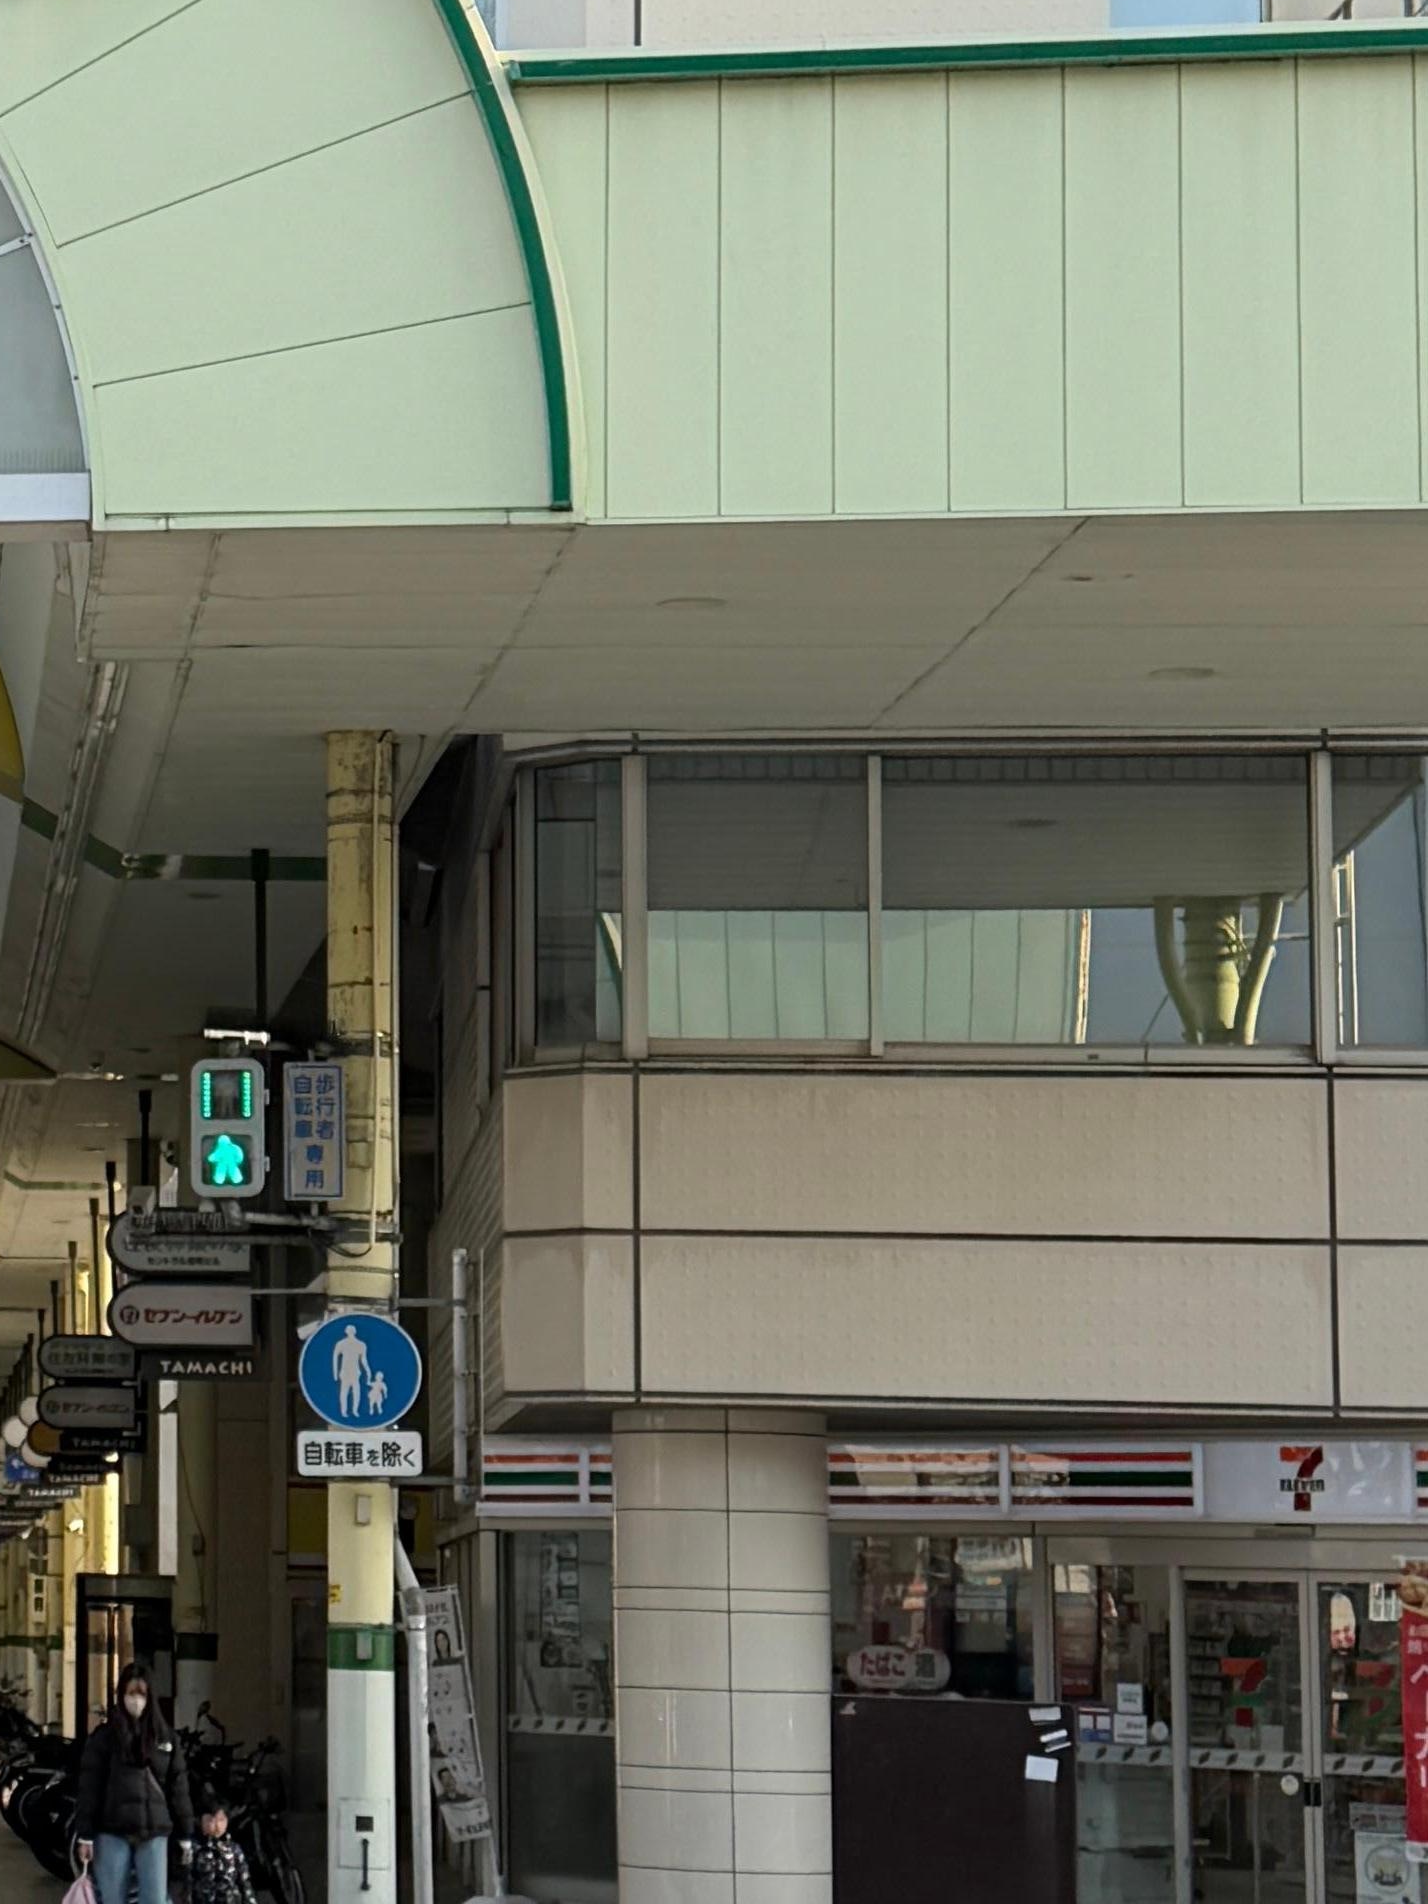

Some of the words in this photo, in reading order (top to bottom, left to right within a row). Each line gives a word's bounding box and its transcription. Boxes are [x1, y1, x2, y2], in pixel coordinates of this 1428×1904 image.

[293, 1074, 312, 1139] 自転車
[315, 1074, 335, 1140] 歩行者
[305, 1144, 324, 1190] 専用
[160, 1360, 253, 1376] TAMACHI
[304, 1442, 416, 1469] 自転車を除く
[860, 1653, 907, 1676] たばこ
